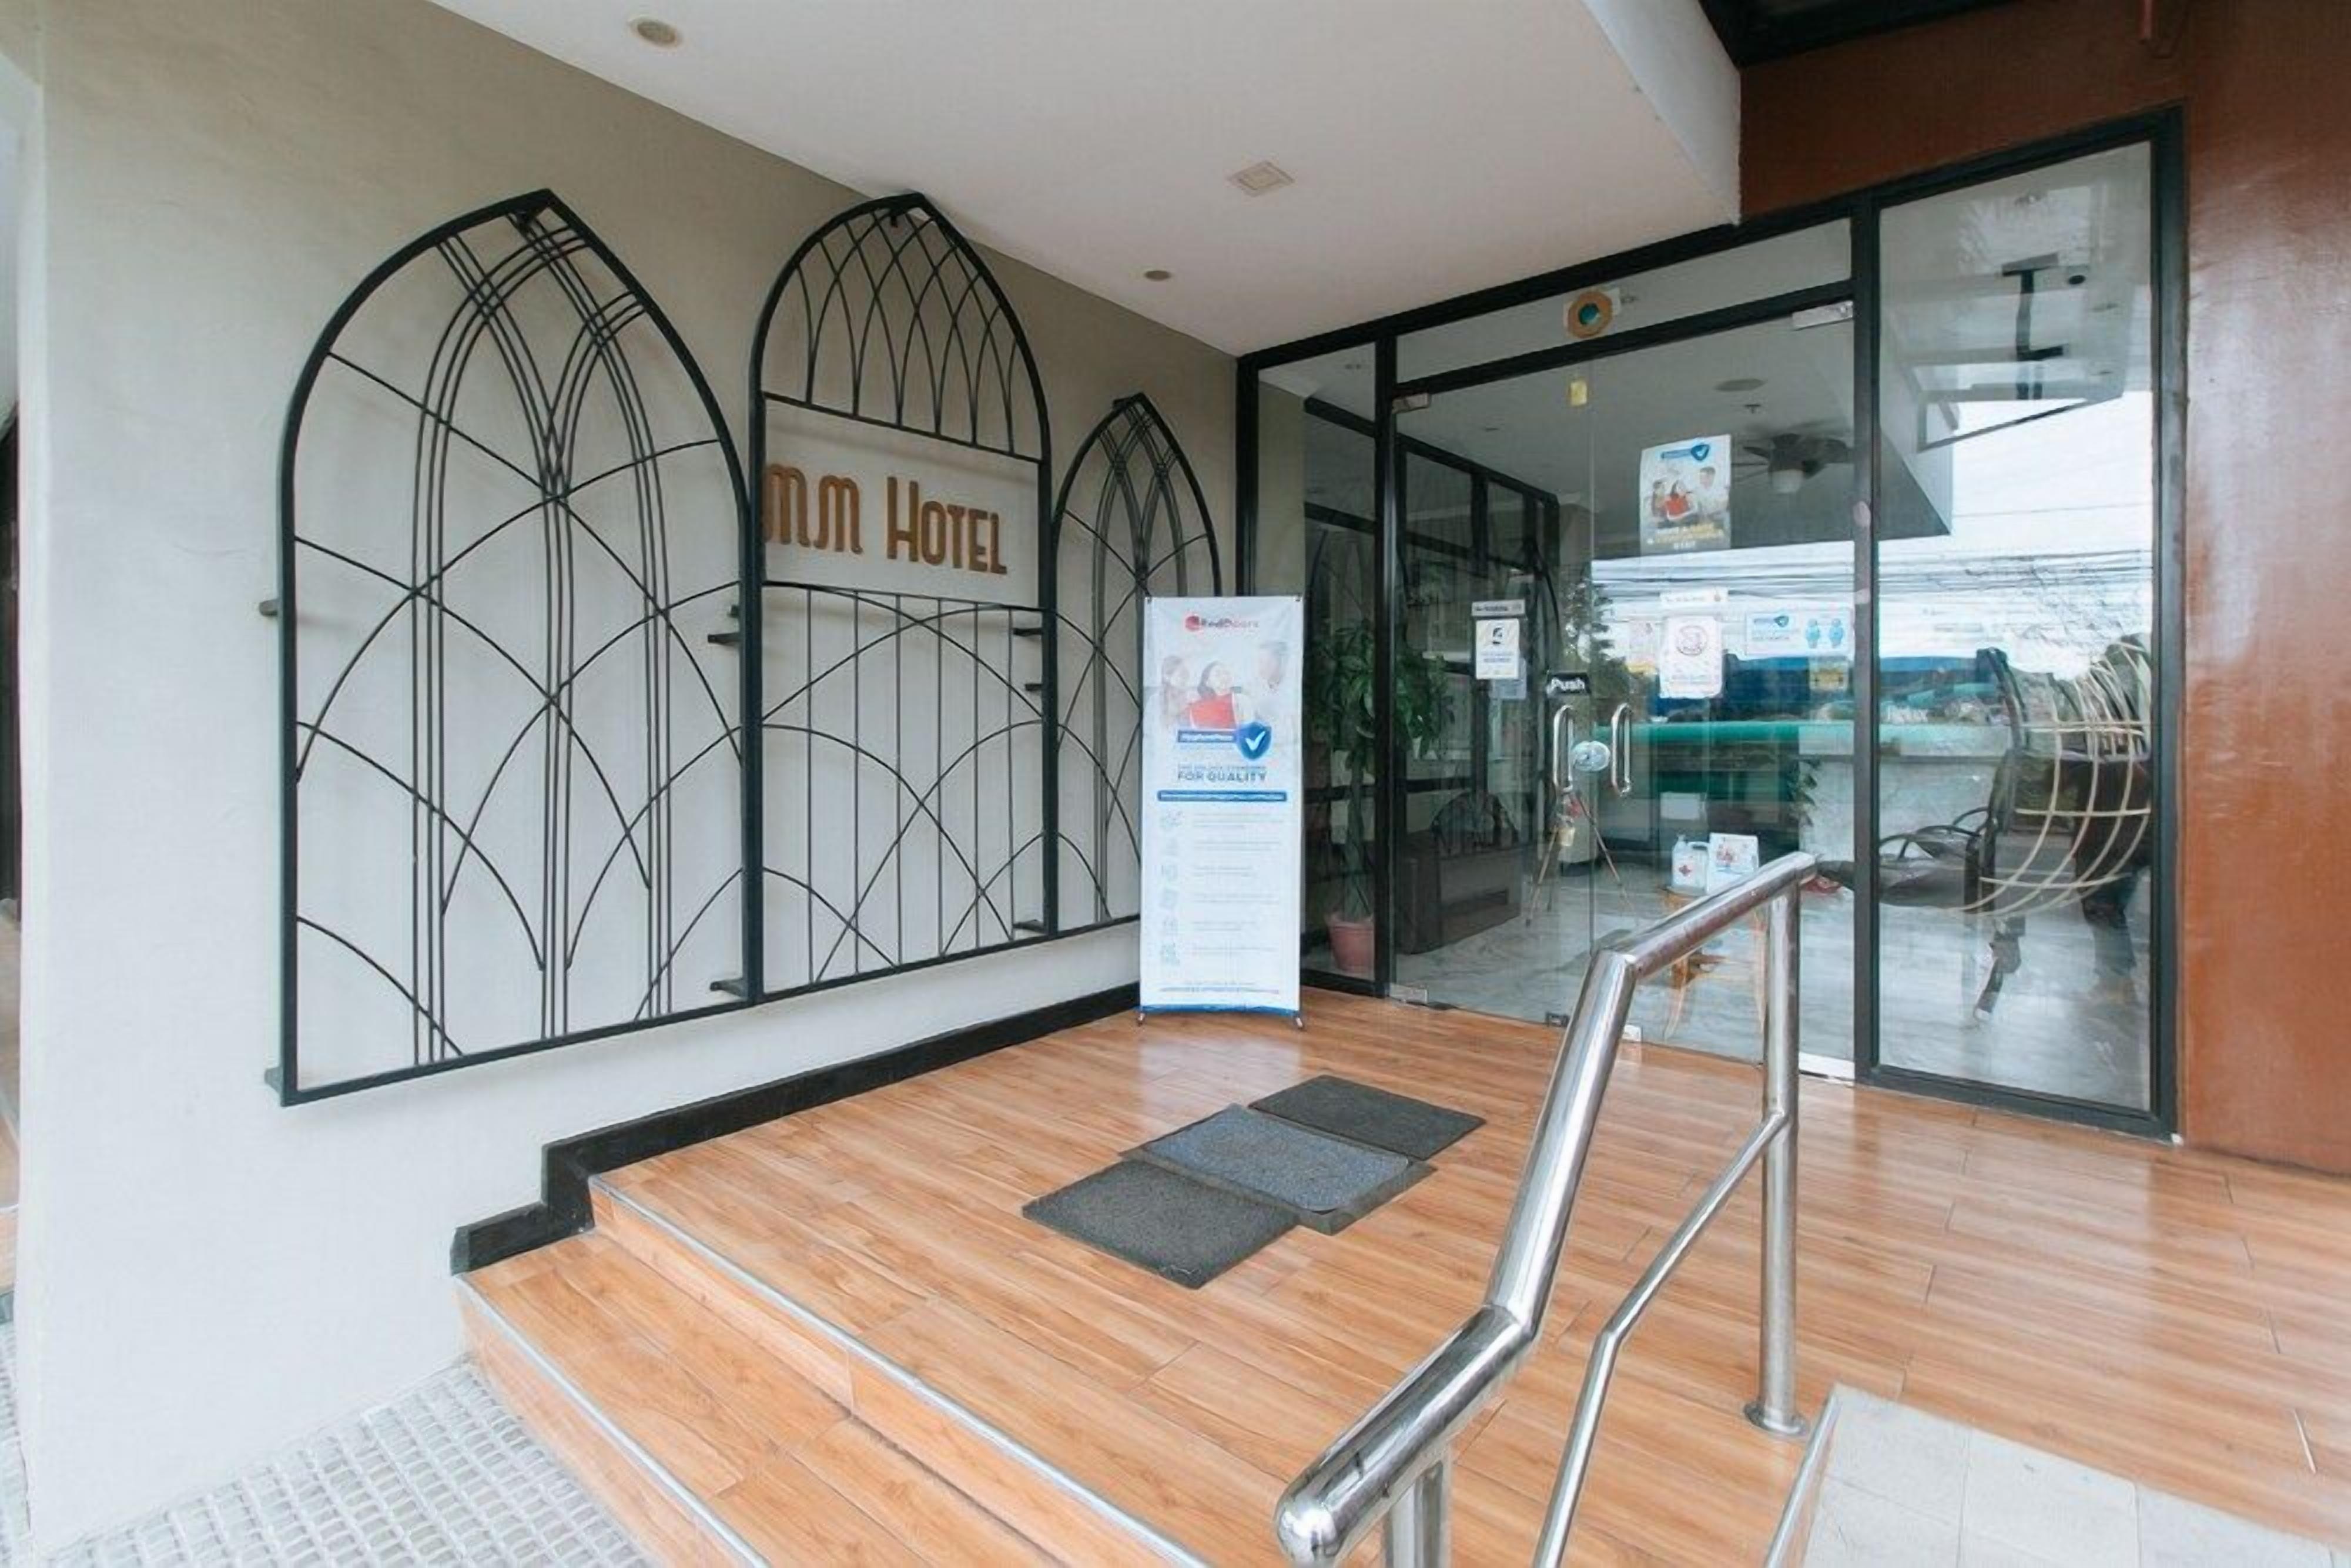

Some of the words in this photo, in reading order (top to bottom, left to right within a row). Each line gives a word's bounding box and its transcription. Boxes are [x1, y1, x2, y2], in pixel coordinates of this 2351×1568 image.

[887, 476, 1007, 574] HOTEL
[1546, 677, 1585, 693] Push
[1178, 770, 1204, 780] FOR
[1207, 770, 1267, 782] QUALITY
